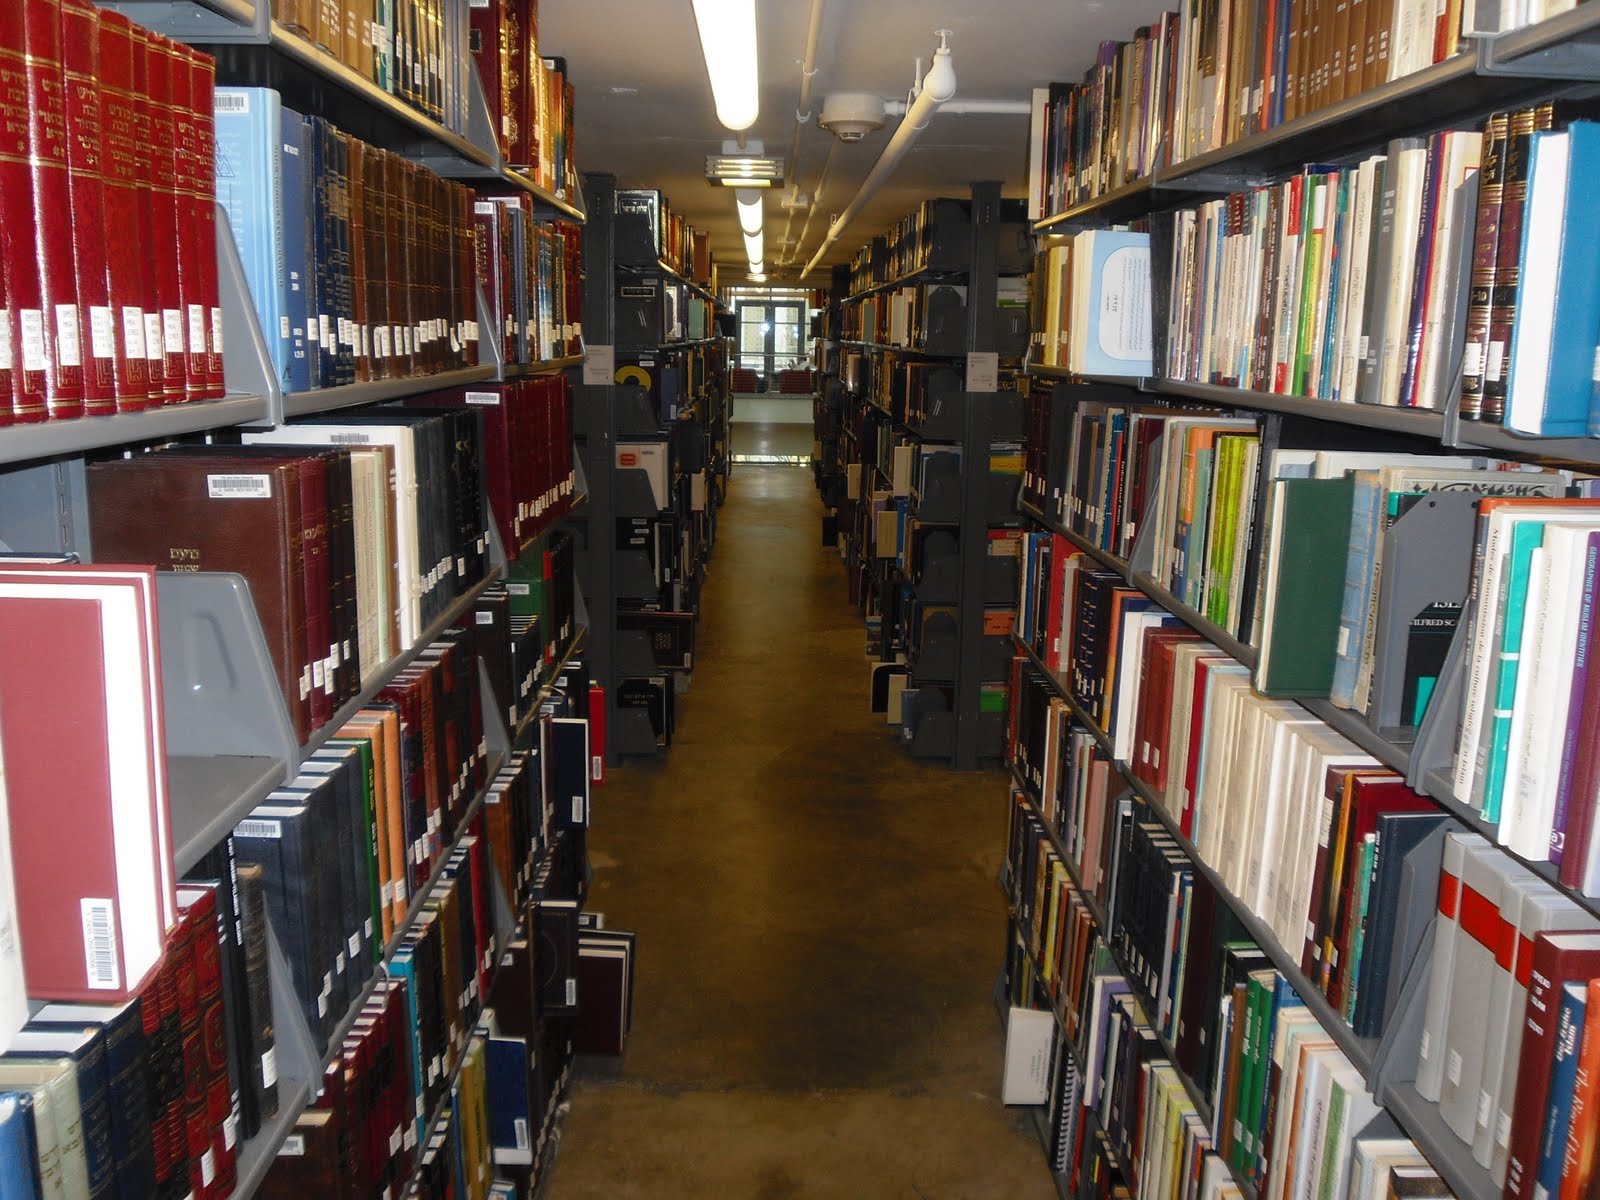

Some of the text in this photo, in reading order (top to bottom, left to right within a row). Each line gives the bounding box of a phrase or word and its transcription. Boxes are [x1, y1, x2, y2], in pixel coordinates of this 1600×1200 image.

[1488, 528, 1498, 560] Modes
[1576, 547, 1597, 668] GEOGRAPHIES OF MUSLIM IDENTITIES
[1458, 760, 1467, 784] Islam
[1565, 1024, 1576, 1055] Islam
[1574, 1067, 1589, 1093] The
[1570, 1095, 1585, 1122] Rise
[1561, 1142, 1578, 1178] Islam
